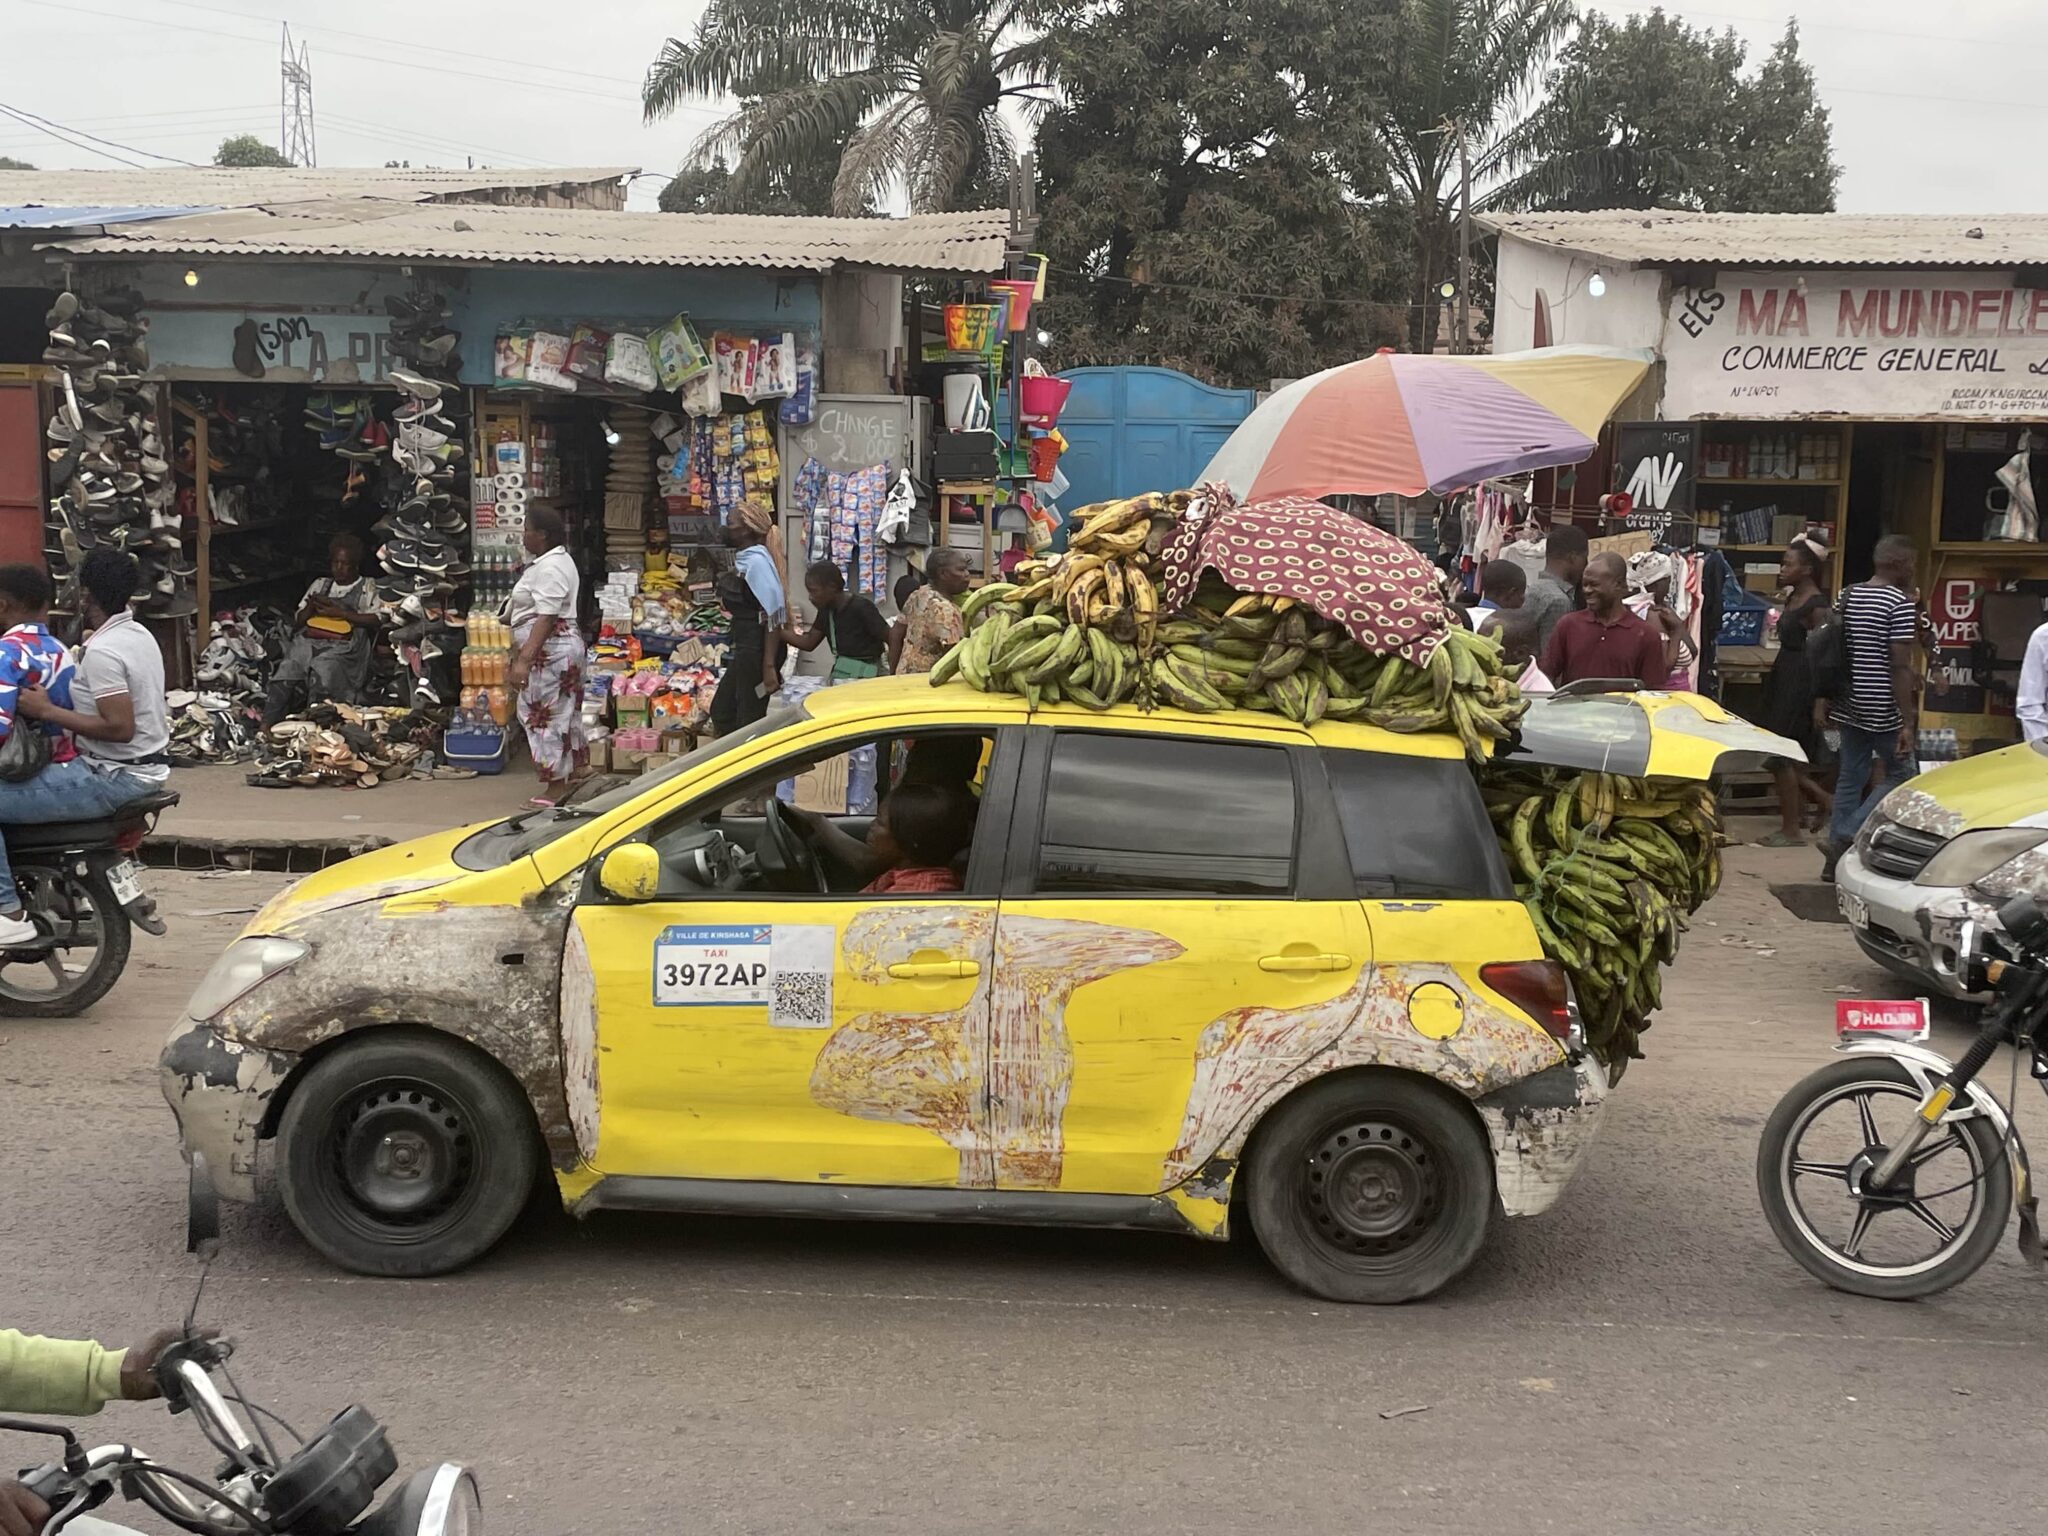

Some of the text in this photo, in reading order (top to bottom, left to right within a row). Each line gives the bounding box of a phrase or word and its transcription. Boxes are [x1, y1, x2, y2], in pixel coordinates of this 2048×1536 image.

[1736, 288, 2048, 339] MA MUNDELE
[1722, 345, 1869, 372] COMMERCE
[1877, 347, 2006, 373] GENERAL
[819, 409, 897, 439] CHANGE
[1625, 511, 1673, 532] orange
[703, 949, 728, 957] TAXI
[663, 963, 767, 986] 3972AP
